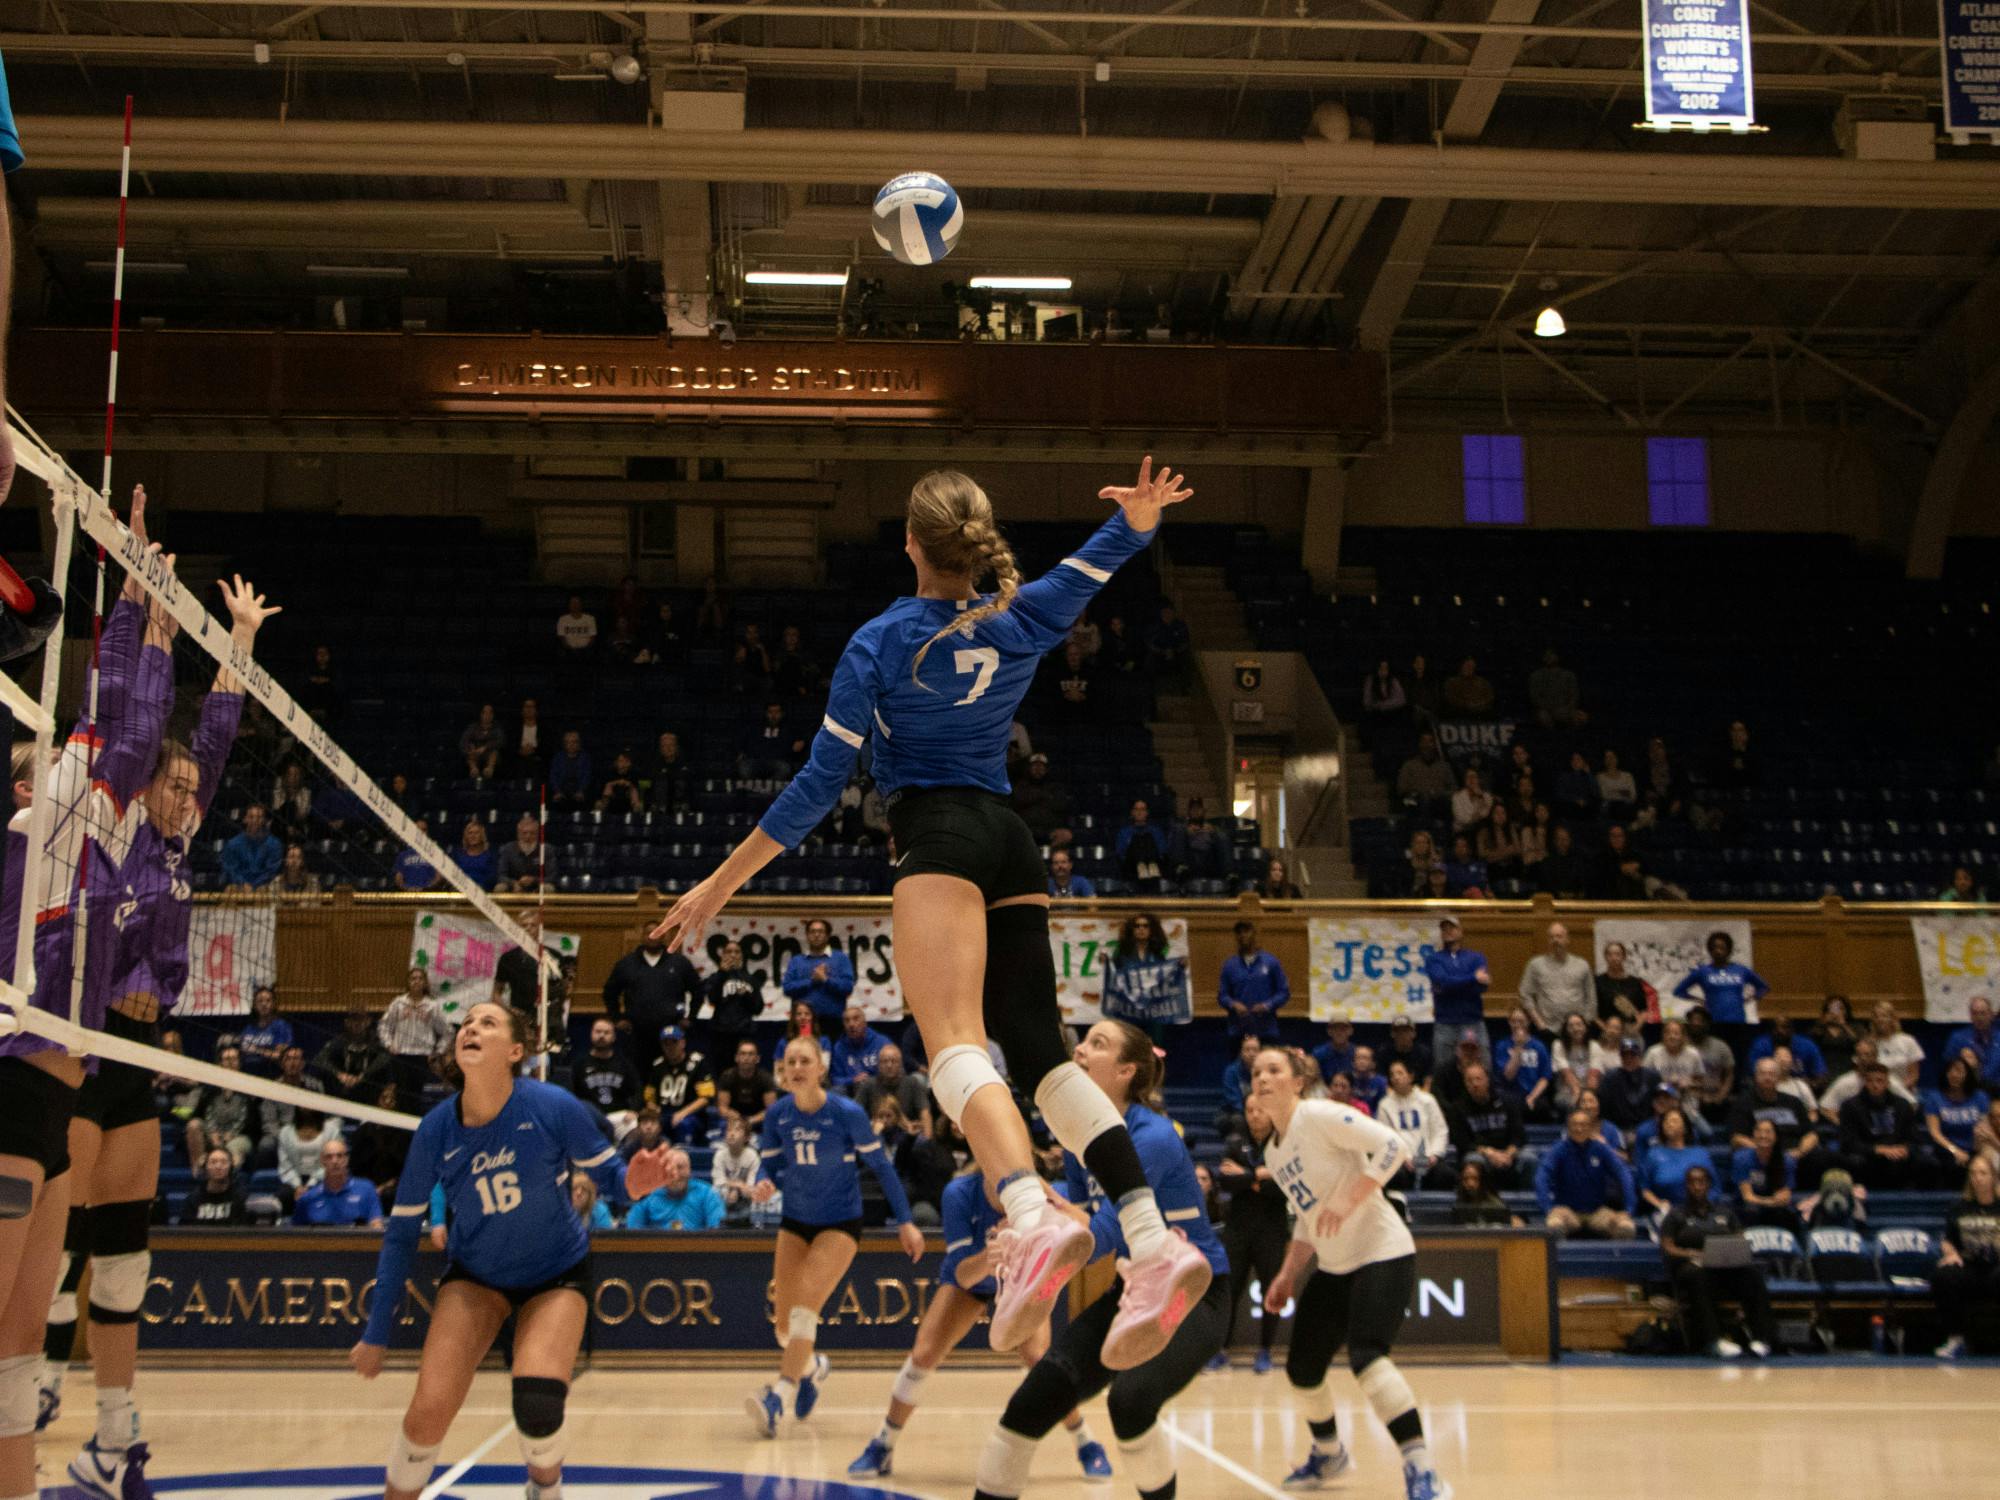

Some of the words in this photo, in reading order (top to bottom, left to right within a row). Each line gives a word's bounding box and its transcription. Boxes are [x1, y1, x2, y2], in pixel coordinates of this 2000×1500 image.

[1673, 7, 1717, 22] COAST
[1651, 22, 1741, 40] CONFERENCE
[1663, 39, 1731, 56] WOMEN'S
[1656, 55, 1740, 73] CHAMPIONS
[1679, 93, 1720, 110] 2002
[454, 363, 617, 387] CAMERON
[631, 364, 759, 390] INDOOR
[770, 366, 922, 393] STADIUM
[953, 646, 1001, 707] 7
[1241, 671, 1257, 688] 6
[792, 1127, 822, 1142] Duke
[471, 1145, 516, 1175] Duke
[793, 1141, 818, 1166] 11
[474, 1171, 522, 1216] 16
[1289, 1180, 1318, 1211] 21
[1810, 1229, 1861, 1253] DUKE
[1878, 1229, 1930, 1253] DUKE
